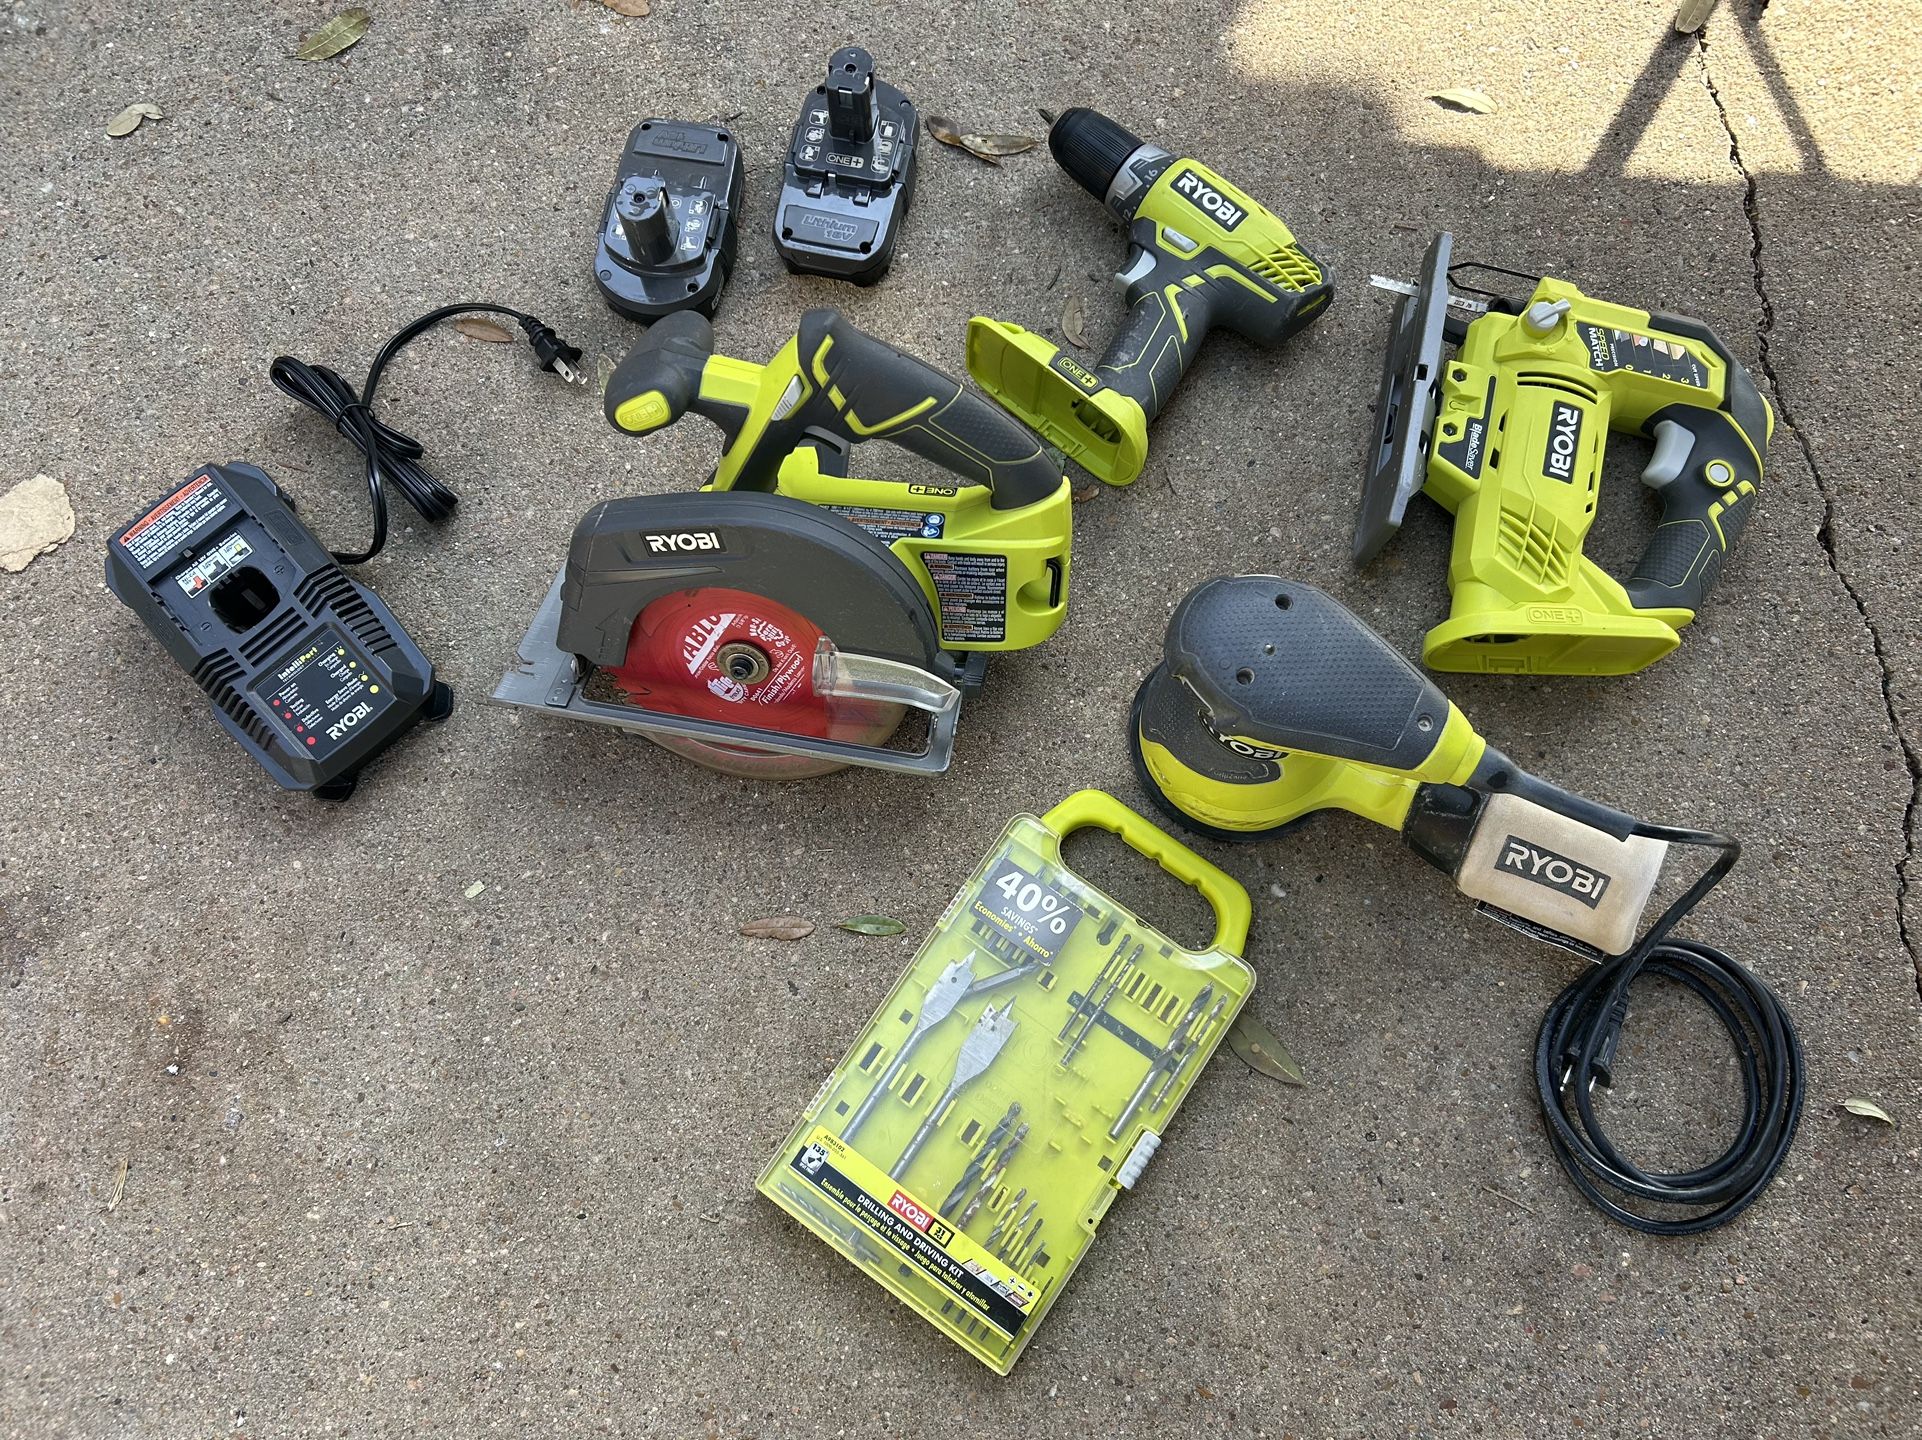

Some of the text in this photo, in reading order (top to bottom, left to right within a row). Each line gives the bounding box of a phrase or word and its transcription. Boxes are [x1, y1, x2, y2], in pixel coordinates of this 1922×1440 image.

[827, 154, 863, 168] ONE+
[1143, 166, 1158, 182] 16
[1176, 171, 1242, 227] RYOBI
[1589, 327, 1604, 368] MATCH
[1594, 327, 1610, 362] SPEED
[1609, 343, 1619, 367] PRECISION
[1060, 359, 1096, 388] ONE+
[1625, 364, 1633, 372] 0
[1662, 373, 1671, 381] 2
[1680, 377, 1689, 385] 3
[1463, 422, 1483, 470] BladeSaver
[1548, 407, 1578, 477] RYOBI
[128, 475, 208, 537] WARNING AVERTISSEMENT ADVERTENCIA
[644, 532, 720, 552] RYOBI
[1532, 610, 1580, 621] ONE+
[277, 646, 318, 680] IntelliPort
[763, 656, 802, 704] Finish/Plywood
[1504, 842, 1604, 898] RYOBI
[995, 871, 1070, 934] 40%
[890, 1193, 930, 1228] RYOBI
[821, 1178, 845, 1199] Ensemble
[842, 1197, 855, 1209] pour
[859, 1209, 881, 1229] perçage
[890, 1232, 911, 1251] vissage
[913, 1251, 930, 1266] Juego
[928, 1262, 940, 1274] para
[938, 1268, 963, 1290] taladrar
[965, 1288, 991, 1311] atornillar
[856, 1194, 964, 1278] DRILLING AND DRIVING KIT
